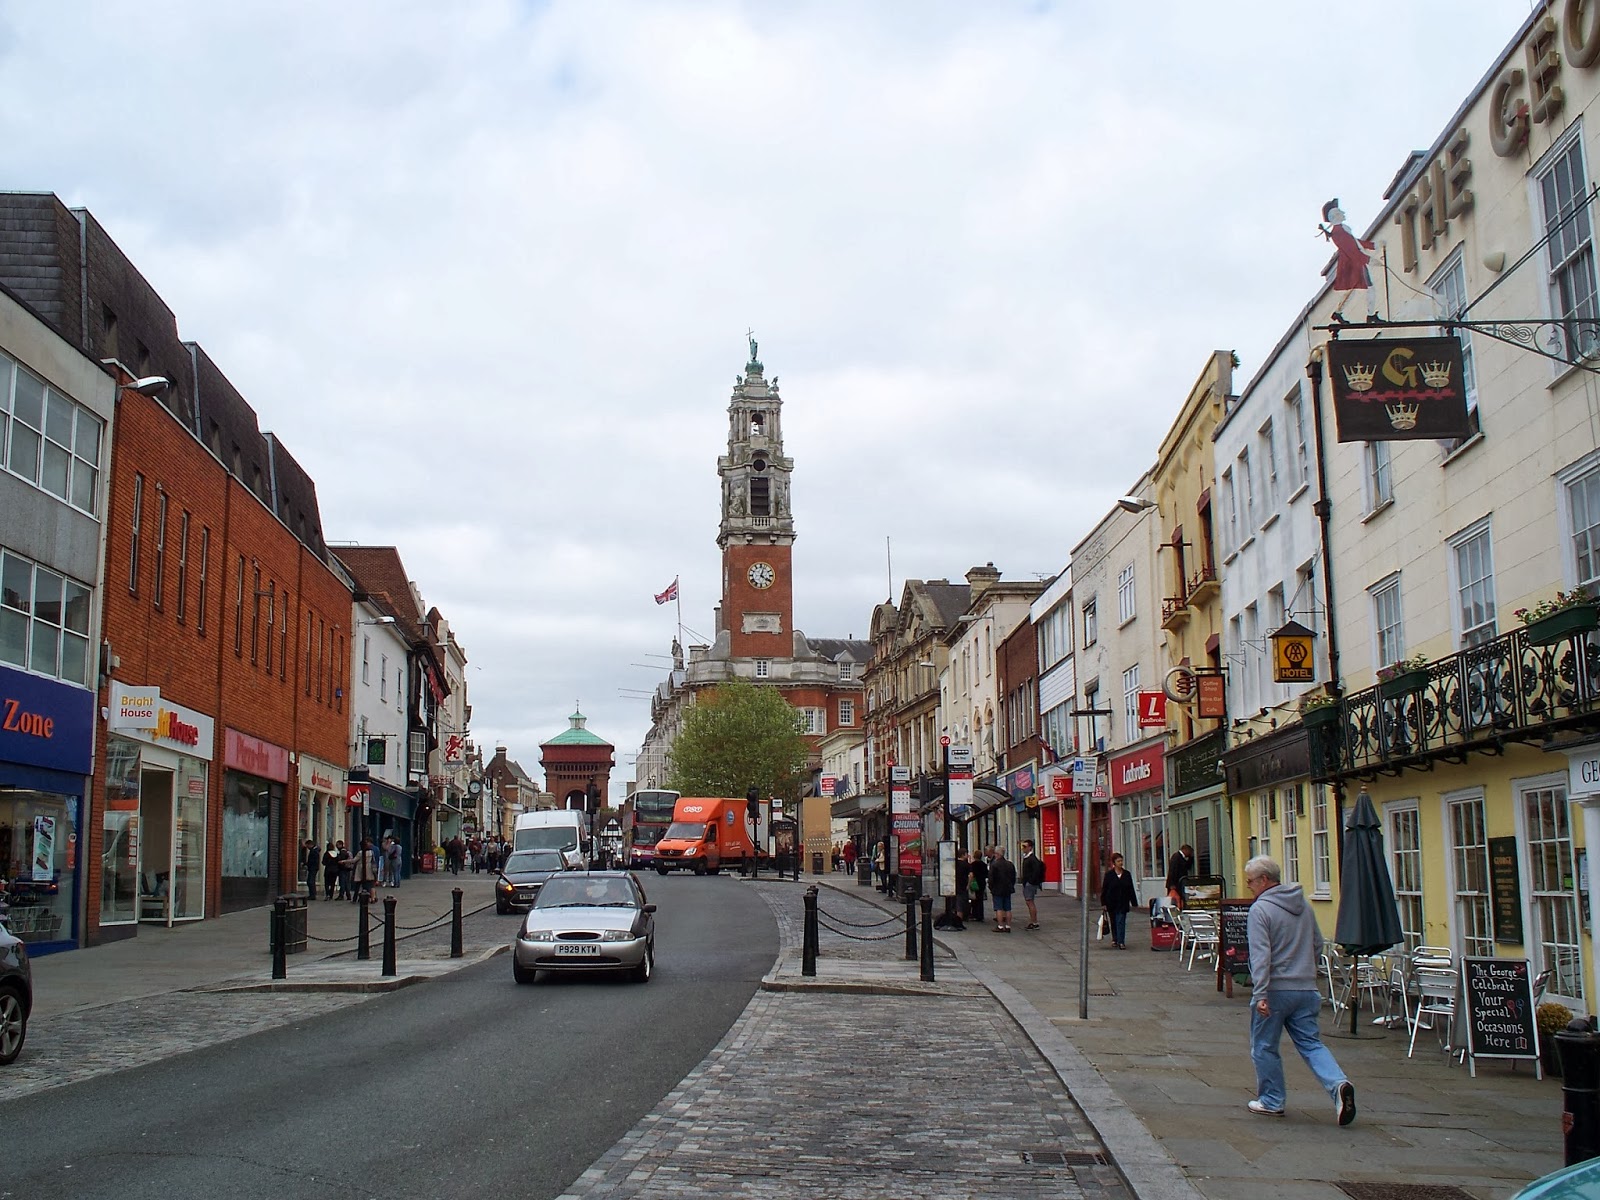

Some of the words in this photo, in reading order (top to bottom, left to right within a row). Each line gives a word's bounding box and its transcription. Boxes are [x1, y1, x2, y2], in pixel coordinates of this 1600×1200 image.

[1394, 127, 1474, 273] THE
[1382, 347, 1418, 388] G
[1281, 668, 1312, 678] HOTEL
[121, 696, 154, 708] Bright
[1148, 697, 1160, 716] L
[3, 698, 55, 739] Zone
[120, 708, 153, 718] House
[1122, 759, 1151, 785] Ladbrokes
[559, 945, 580, 954] P929
[581, 945, 597, 954] KTW
[1471, 963, 1487, 976] The
[1489, 963, 1518, 980] George
[1471, 978, 1515, 992] Celebrate
[1477, 991, 1505, 1006] Your
[1474, 1006, 1511, 1021] Special
[1476, 1020, 1524, 1034] Occasions
[1484, 1034, 1511, 1048] Here
